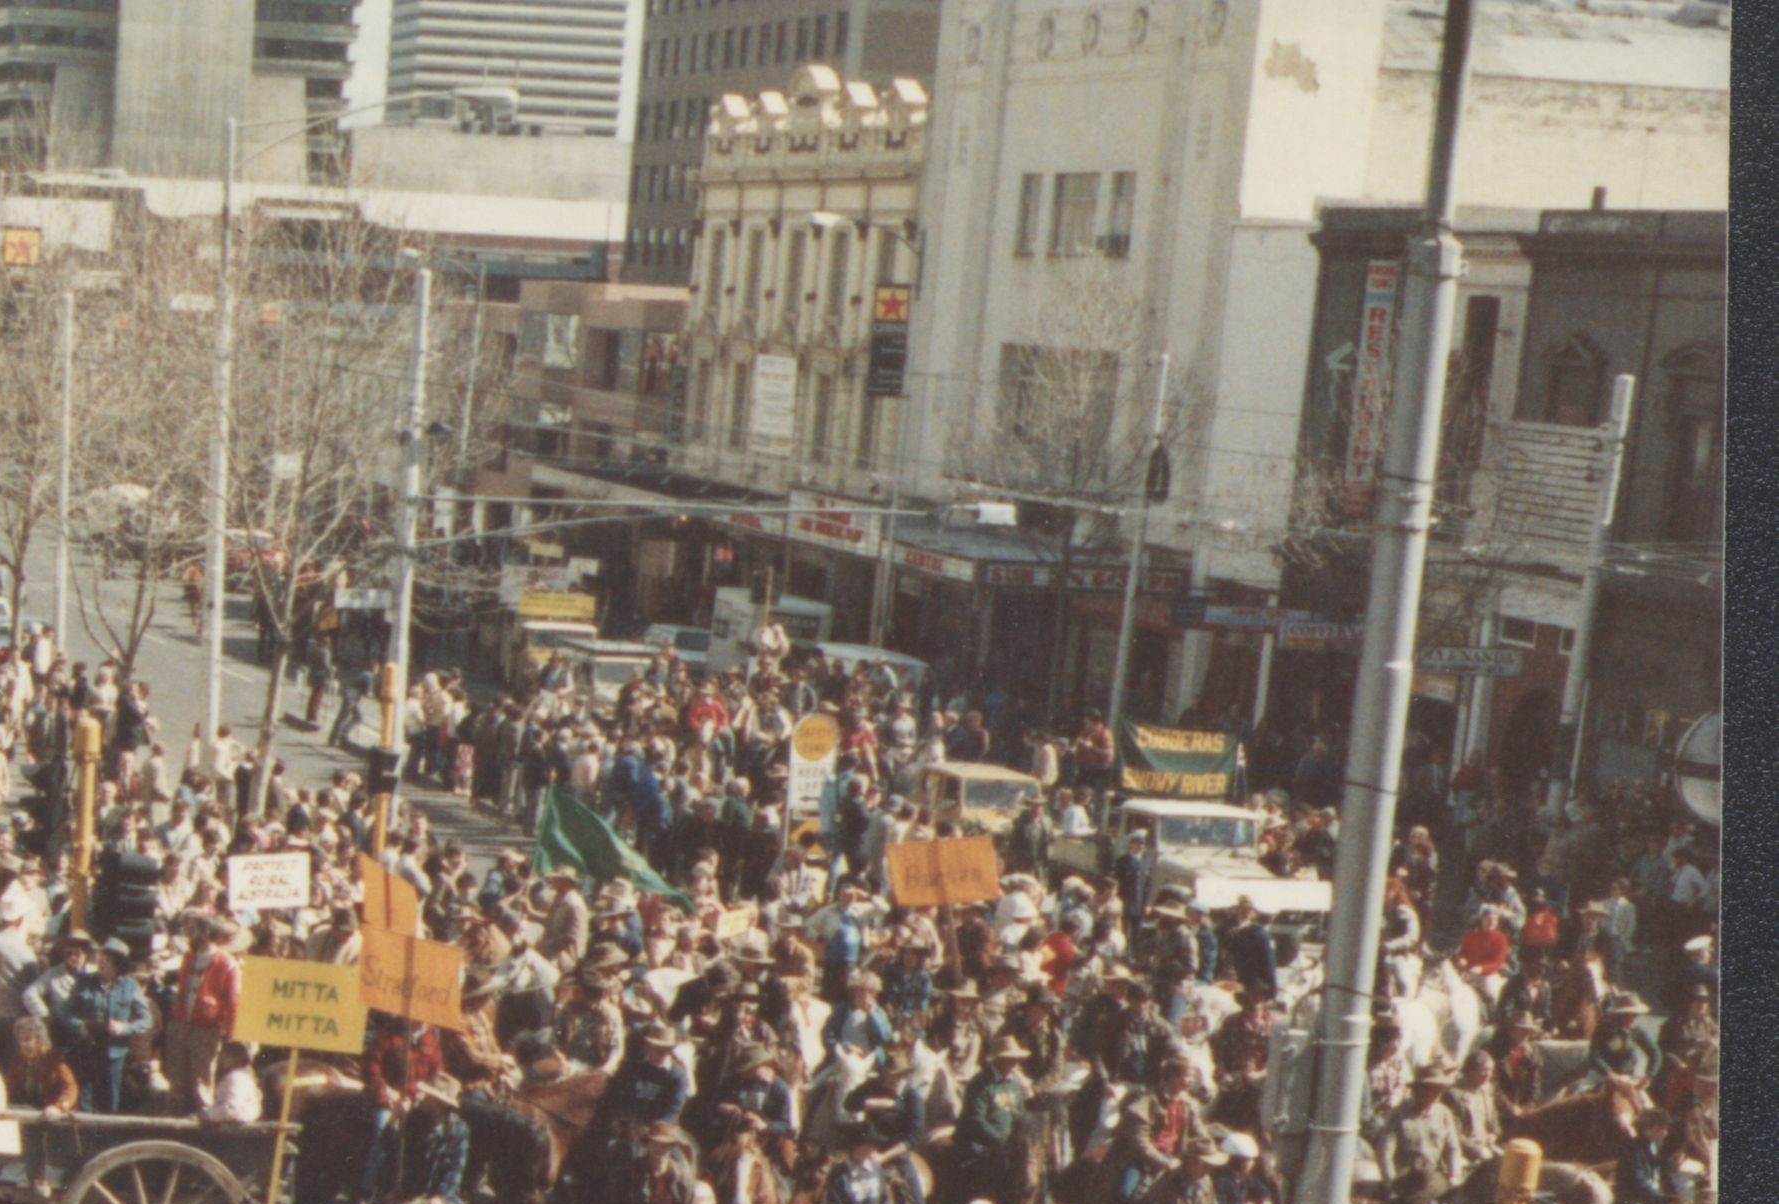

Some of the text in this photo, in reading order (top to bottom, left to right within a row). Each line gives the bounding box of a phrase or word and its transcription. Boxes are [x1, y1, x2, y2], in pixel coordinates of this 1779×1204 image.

[1179, 772, 1227, 796] RIVER
[271, 978, 340, 1004] MITTA
[265, 1011, 340, 1038] MITTA
